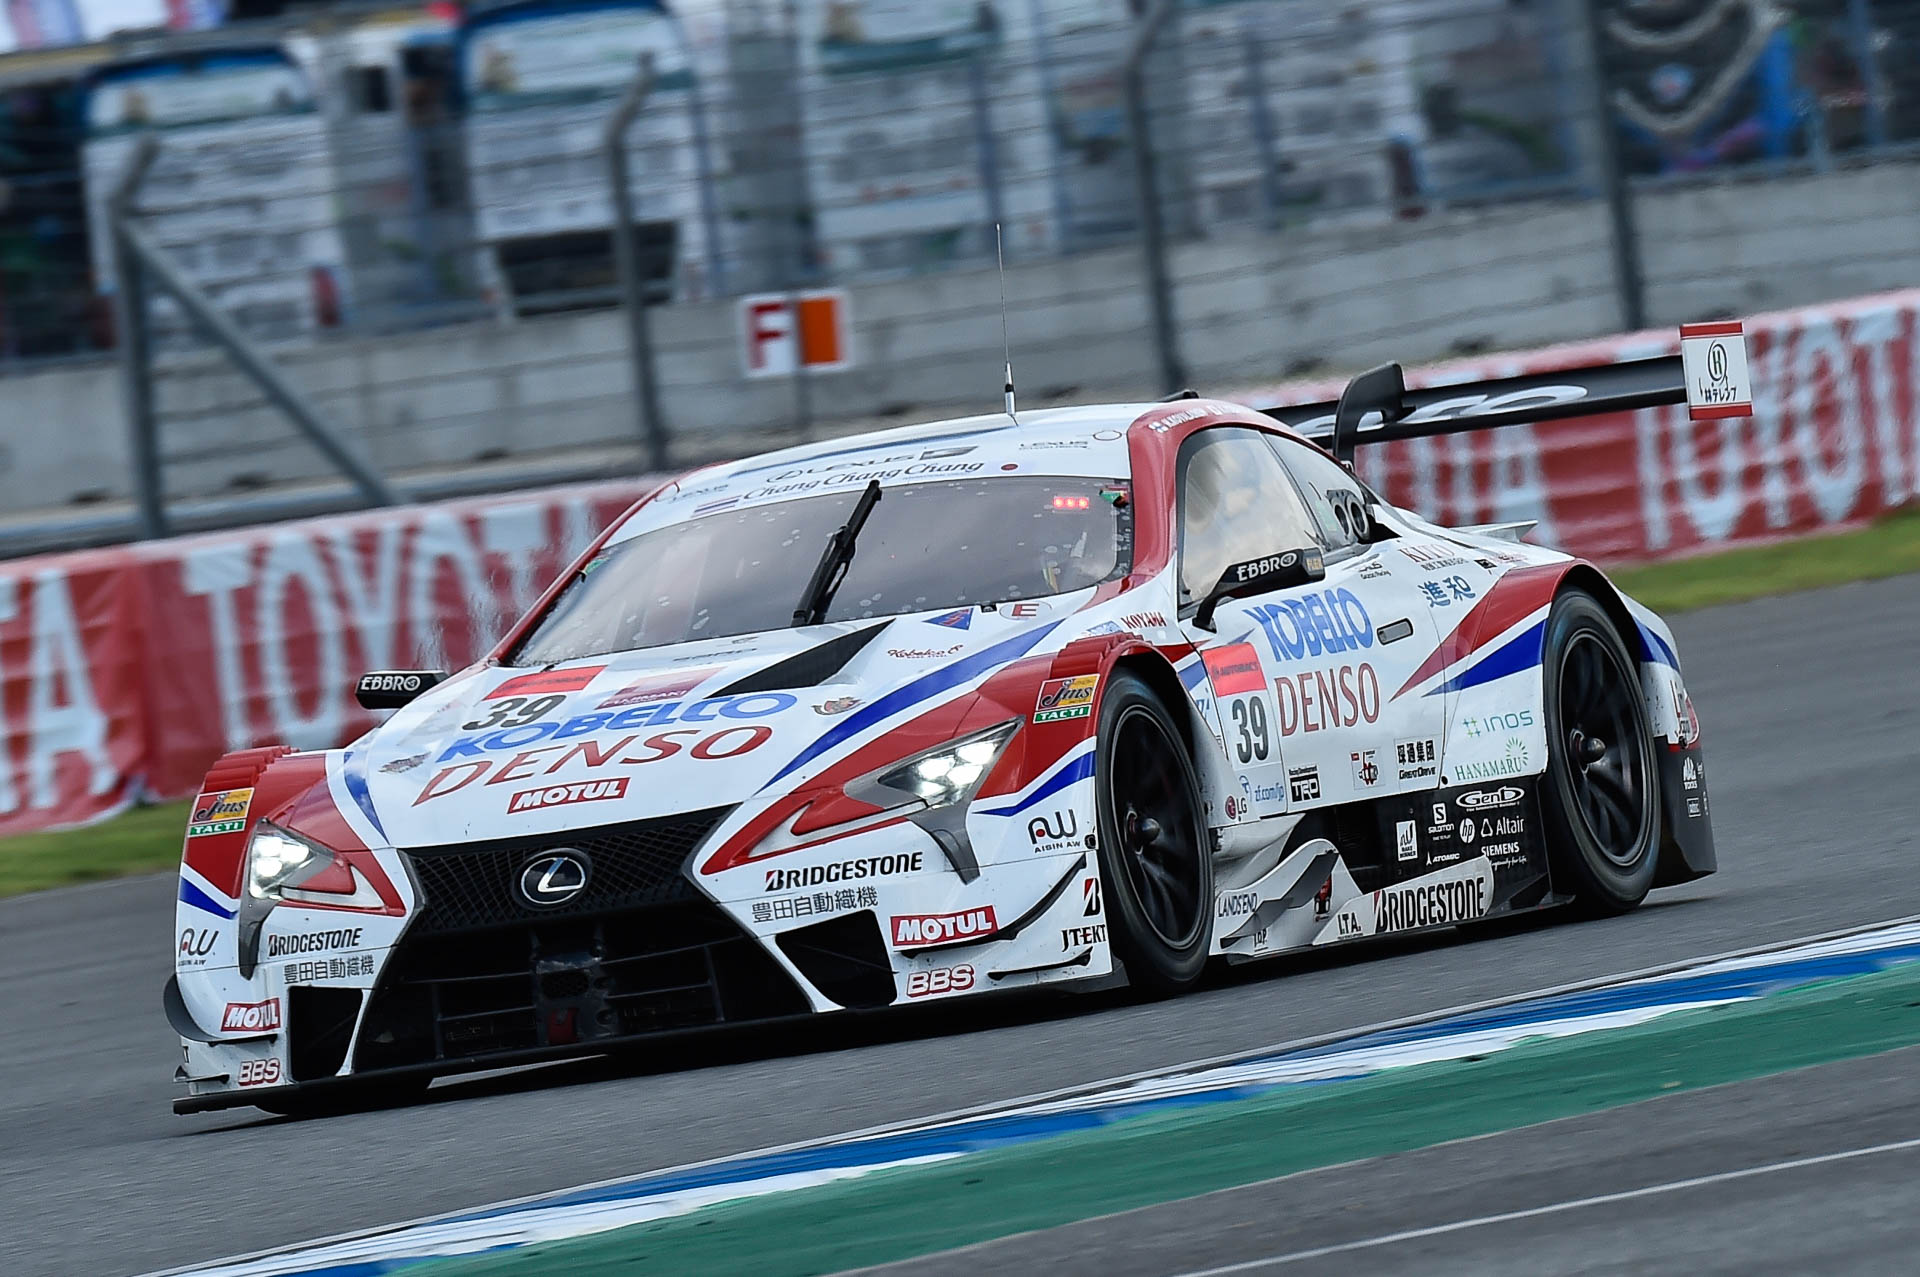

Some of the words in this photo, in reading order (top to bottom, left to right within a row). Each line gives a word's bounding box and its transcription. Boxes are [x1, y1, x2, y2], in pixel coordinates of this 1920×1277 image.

[748, 301, 795, 370] F
[743, 478, 822, 500] Chang
[822, 468, 902, 488] Chang
[903, 461, 985, 476] Chang
[1236, 552, 1298, 581] EBBRO
[1242, 587, 1373, 662] KOBELCO
[359, 674, 421, 692] EBBRO
[462, 695, 566, 731] 39
[1040, 707, 1084, 720] TACTI
[1274, 662, 1379, 737] DENSO
[435, 693, 797, 764] KOBELCO
[1232, 695, 1270, 764] 39
[412, 725, 774, 808] DENSO
[1454, 757, 1523, 781] HANAMARU
[519, 780, 621, 811] MOTUL
[193, 821, 240, 834] TACTI
[1496, 815, 1525, 836] Altair
[1481, 842, 1520, 858] SIEMENS
[764, 851, 923, 893] BRIDGESTONE
[751, 886, 879, 924] 豊田自動織機
[1374, 876, 1485, 934] BRIDGESTONE
[268, 928, 362, 957] BRIDGESTONE
[896, 915, 992, 943] MOTUL
[1061, 924, 1107, 953] JTEKT
[283, 955, 375, 985] 豊田自動織機
[907, 963, 975, 999] BBS
[224, 1002, 280, 1028] MOTUL
[238, 1058, 281, 1087] BBS
